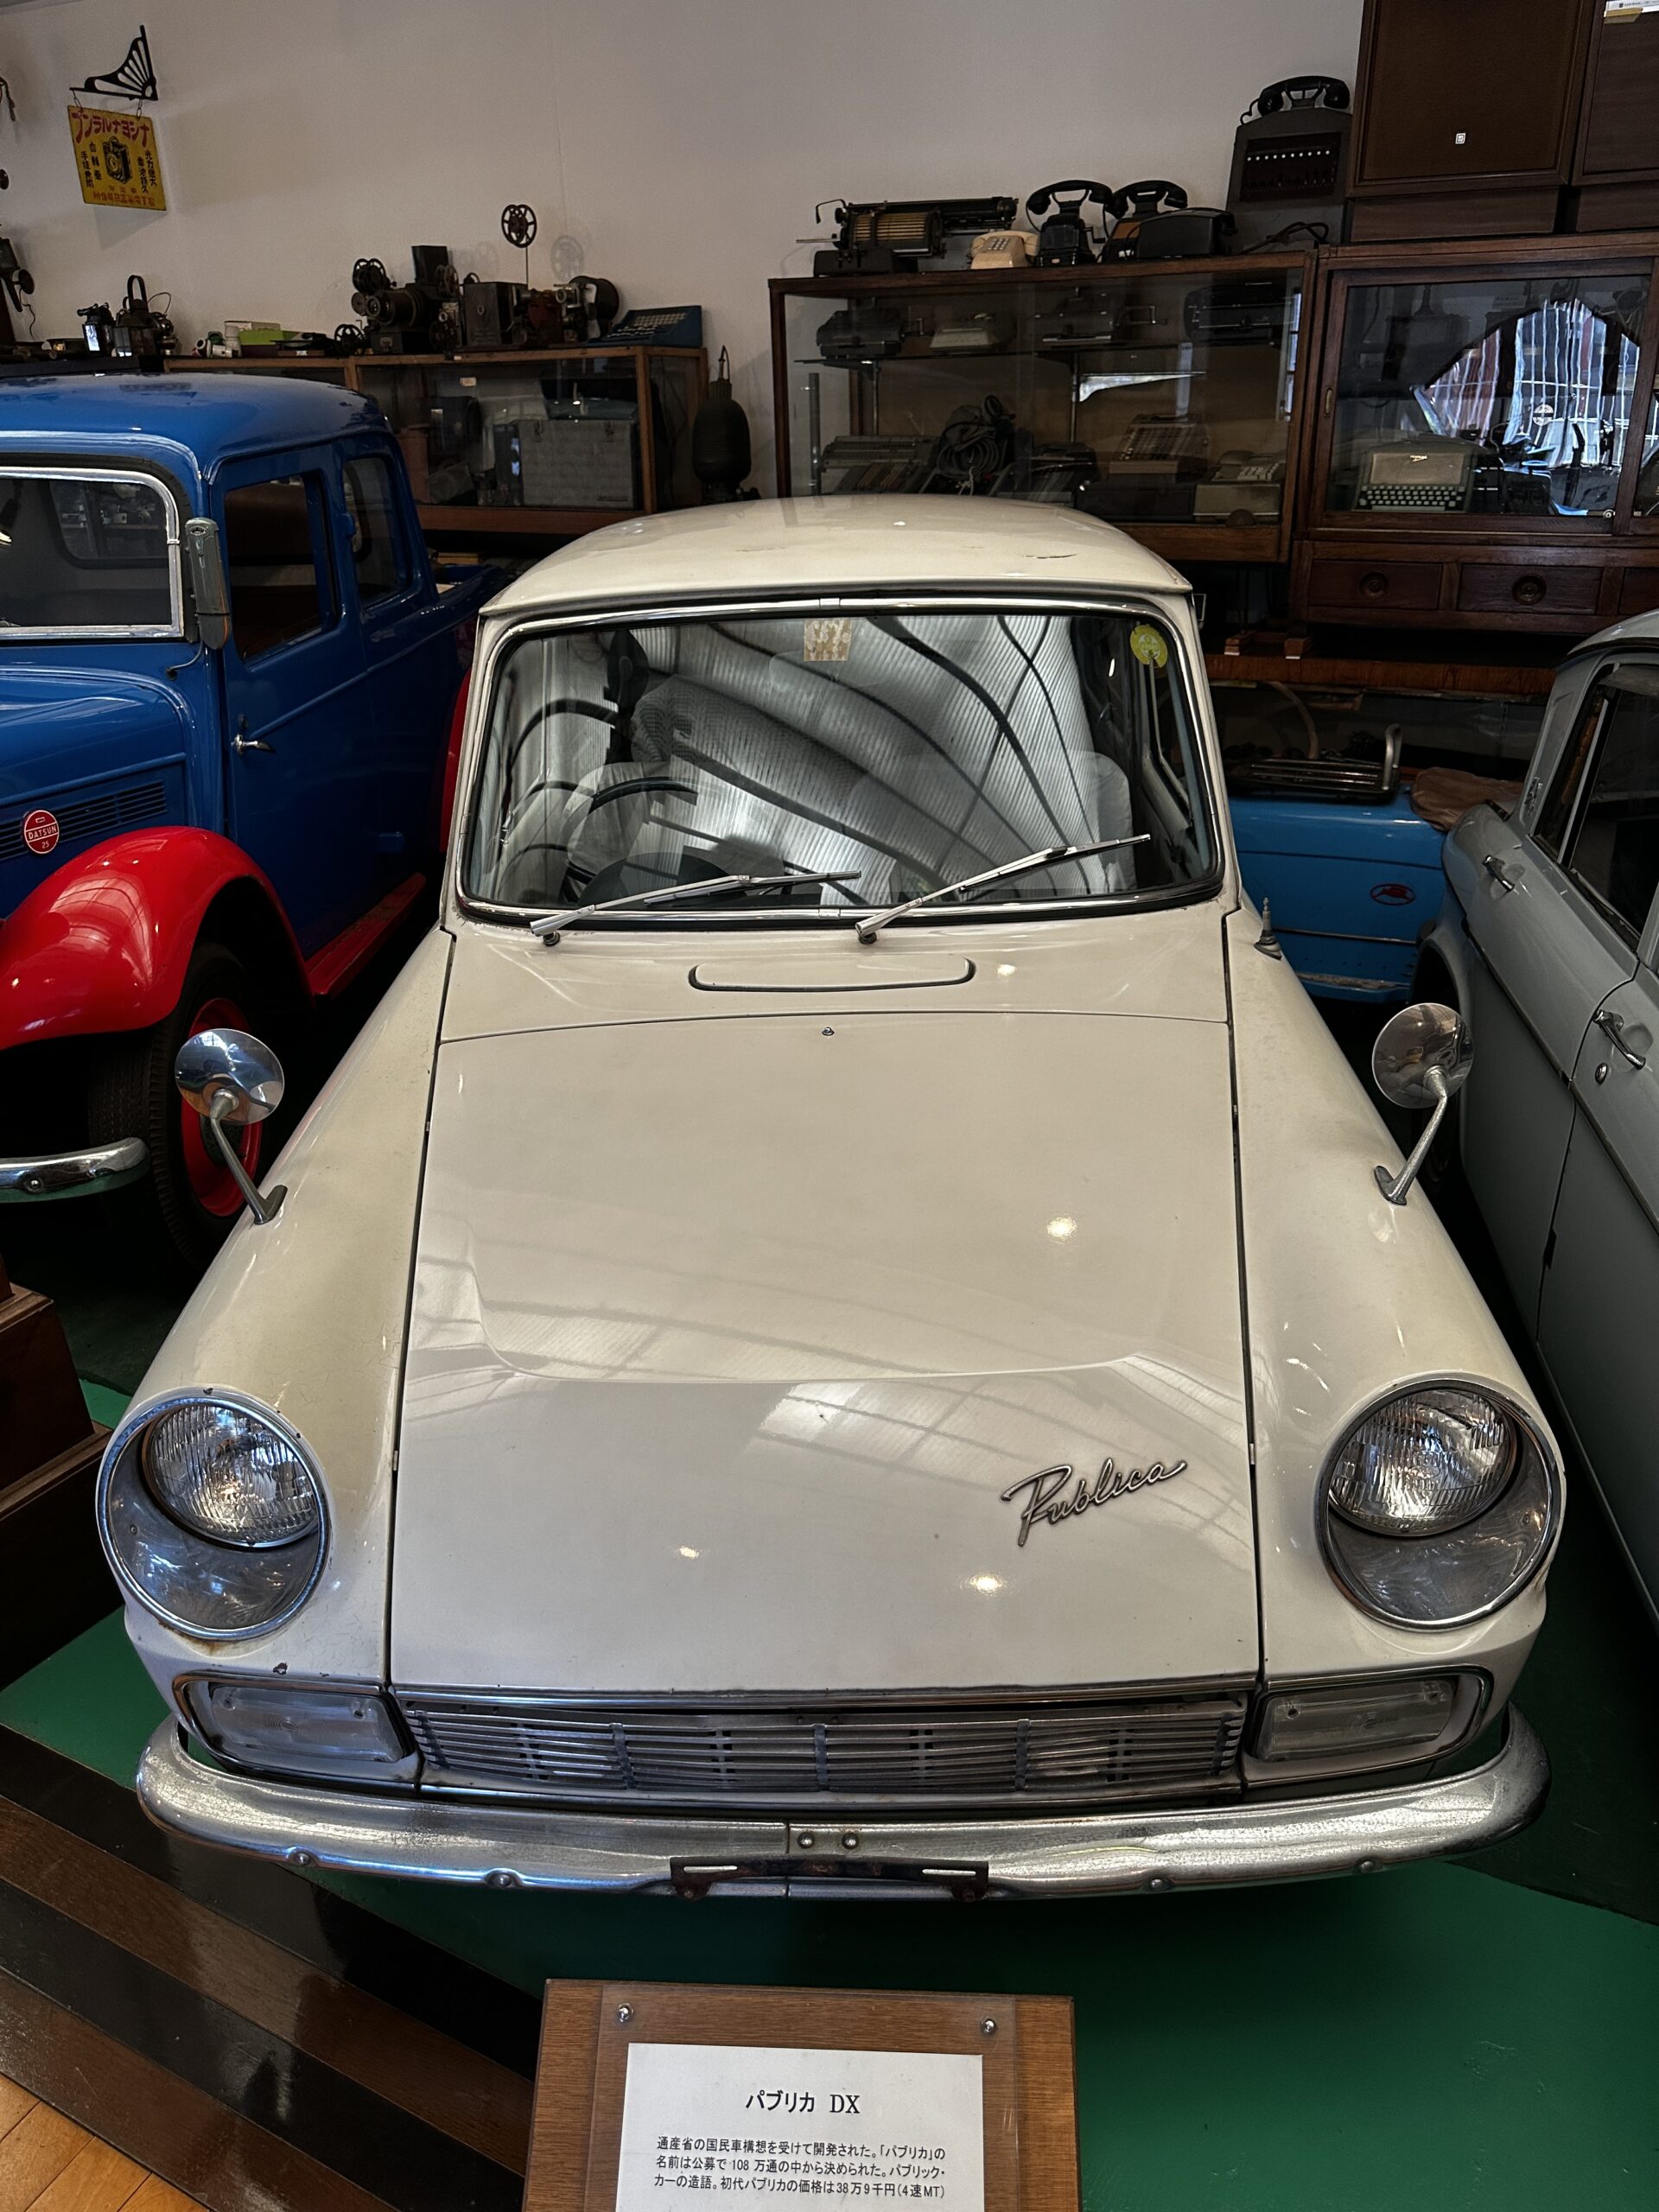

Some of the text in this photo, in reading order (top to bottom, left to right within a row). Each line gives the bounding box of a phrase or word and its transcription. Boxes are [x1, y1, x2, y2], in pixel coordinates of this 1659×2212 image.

[29, 825, 57, 840] DATSUN
[1001, 1457, 1188, 1547] Publica
[746, 2089, 861, 2114] パブリカ DX
